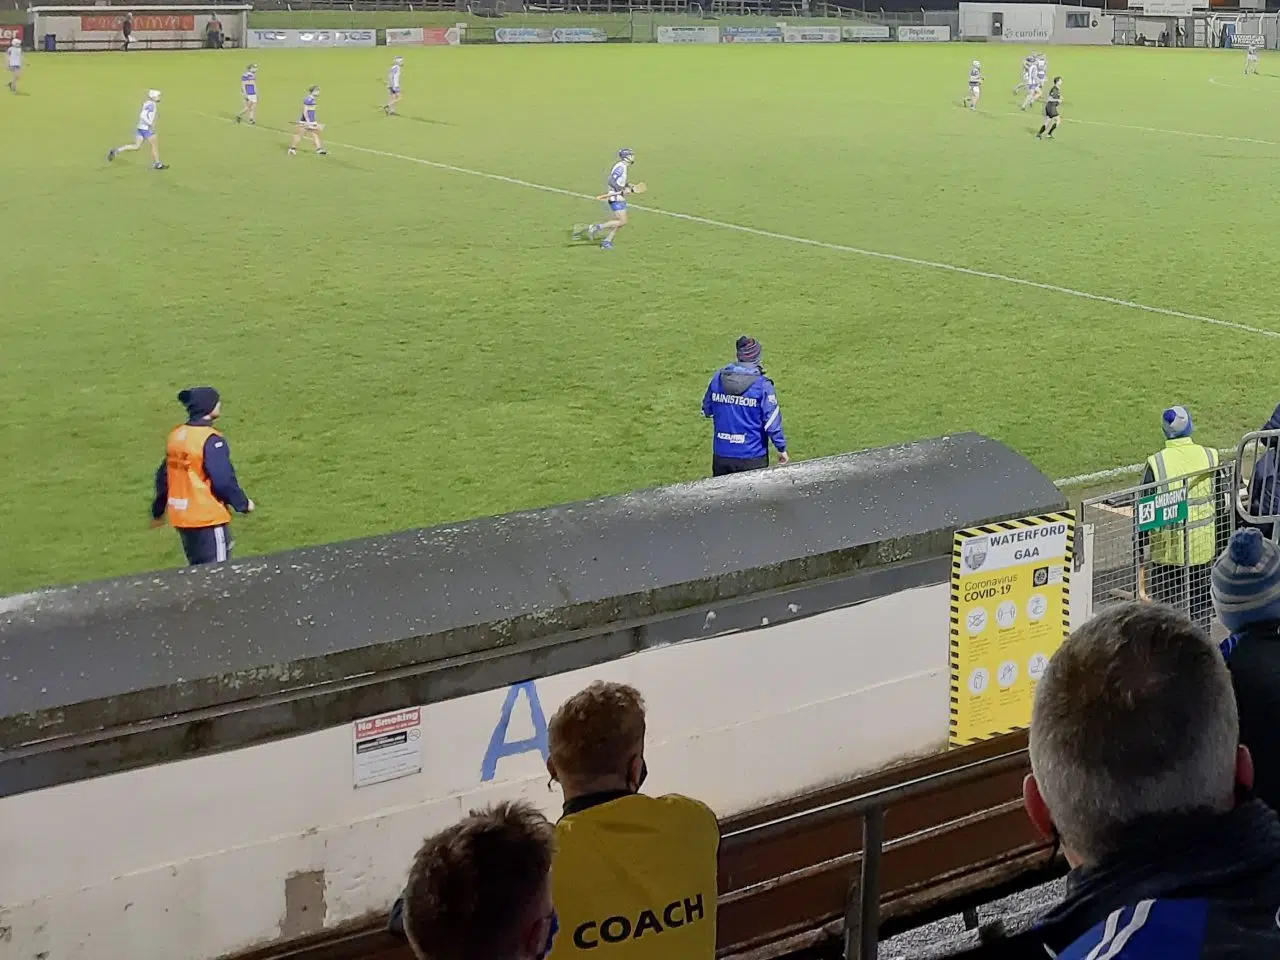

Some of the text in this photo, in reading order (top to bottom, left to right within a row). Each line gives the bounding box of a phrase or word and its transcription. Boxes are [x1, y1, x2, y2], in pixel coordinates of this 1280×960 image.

[1155, 487, 1186, 508] EMERGENCY
[1163, 505, 1178, 520] EXIT
[990, 524, 1065, 547] WATERFORD
[1014, 547, 1040, 560] GAA
[965, 574, 1018, 591] Coronavirus
[964, 584, 1011, 602] COVID-19
[358, 723, 373, 731] No
[375, 711, 419, 728] Smoking
[480, 680, 550, 782] A
[573, 893, 704, 949] COACH
